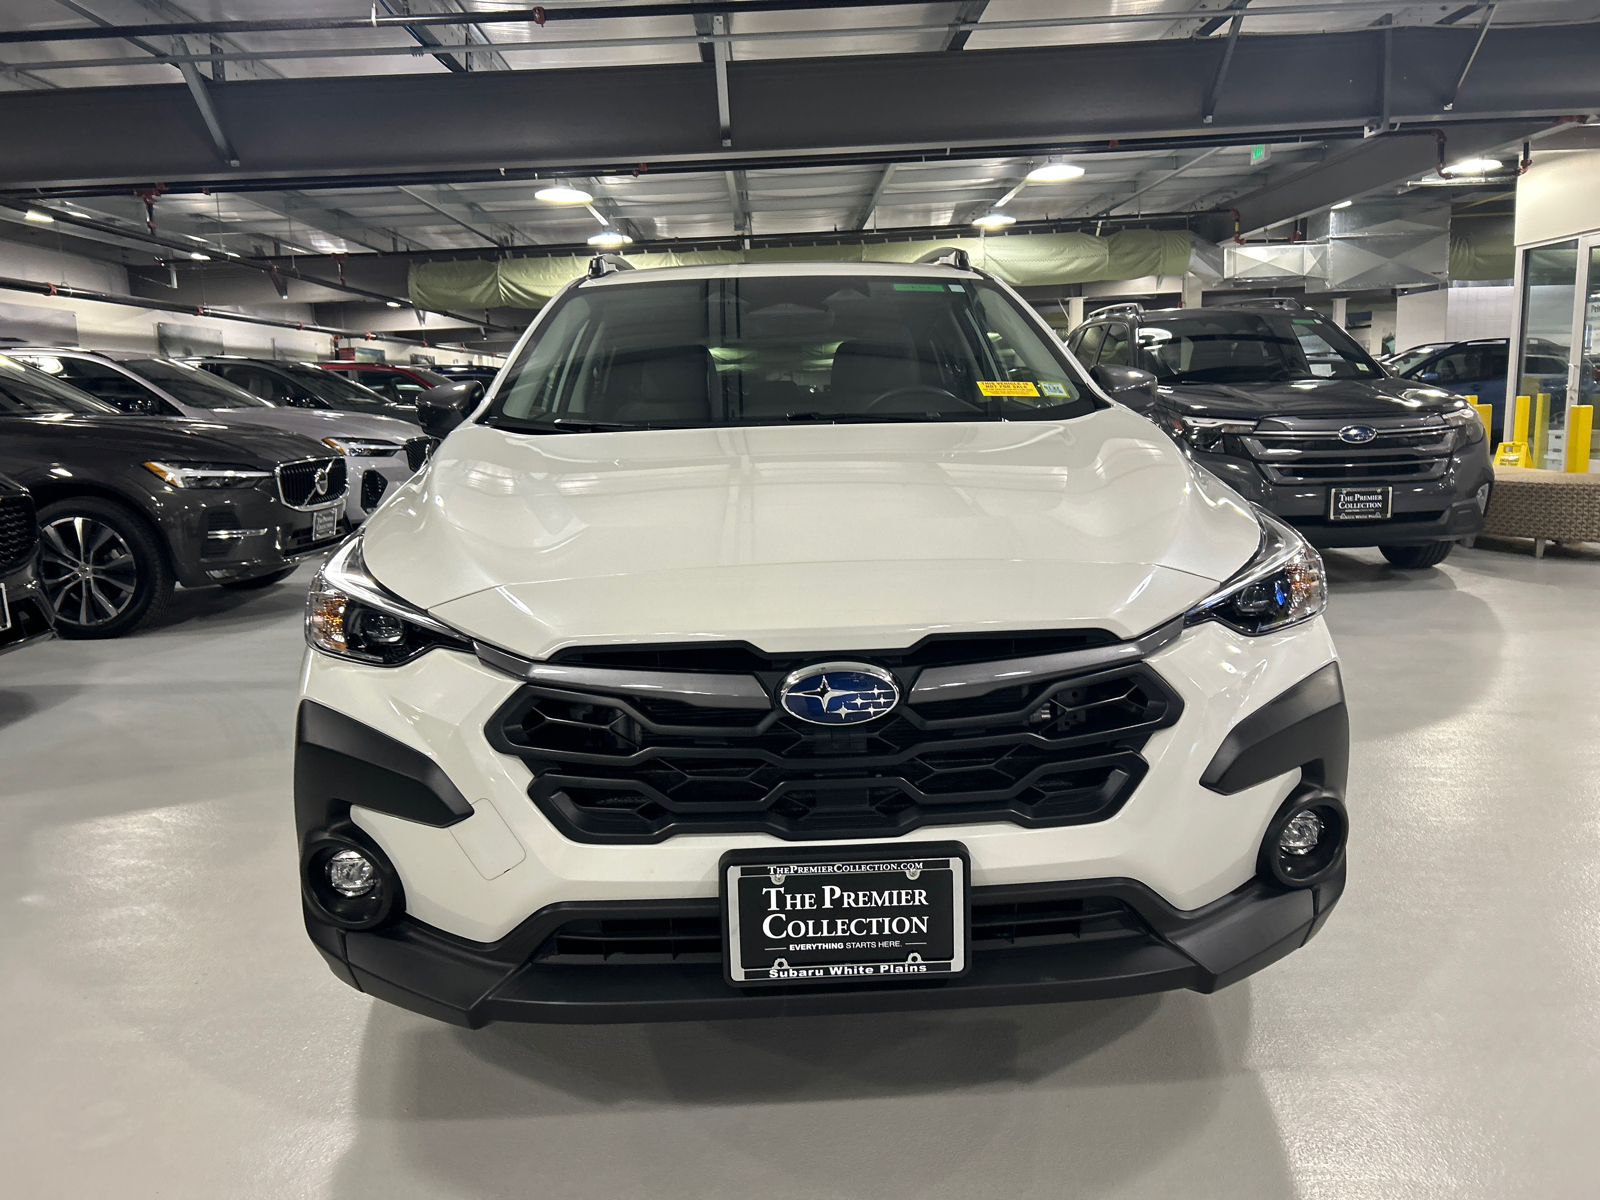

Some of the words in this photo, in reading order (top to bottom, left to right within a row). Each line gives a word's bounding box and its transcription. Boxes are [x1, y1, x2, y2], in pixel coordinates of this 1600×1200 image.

[1339, 494, 1354, 502] THE
[1354, 493, 1382, 501] PREMIER
[1338, 501, 1382, 509] COLLECTION
[762, 886, 817, 911] THE
[822, 885, 929, 909] PREMIER
[762, 913, 930, 939] COLLECTION
[789, 942, 844, 951] EVERYTHING
[845, 941, 877, 950] STARTS
[878, 940, 903, 949] HERE.
[768, 967, 824, 979] Subaru
[829, 965, 874, 976] White
[880, 963, 927, 974] Plains
